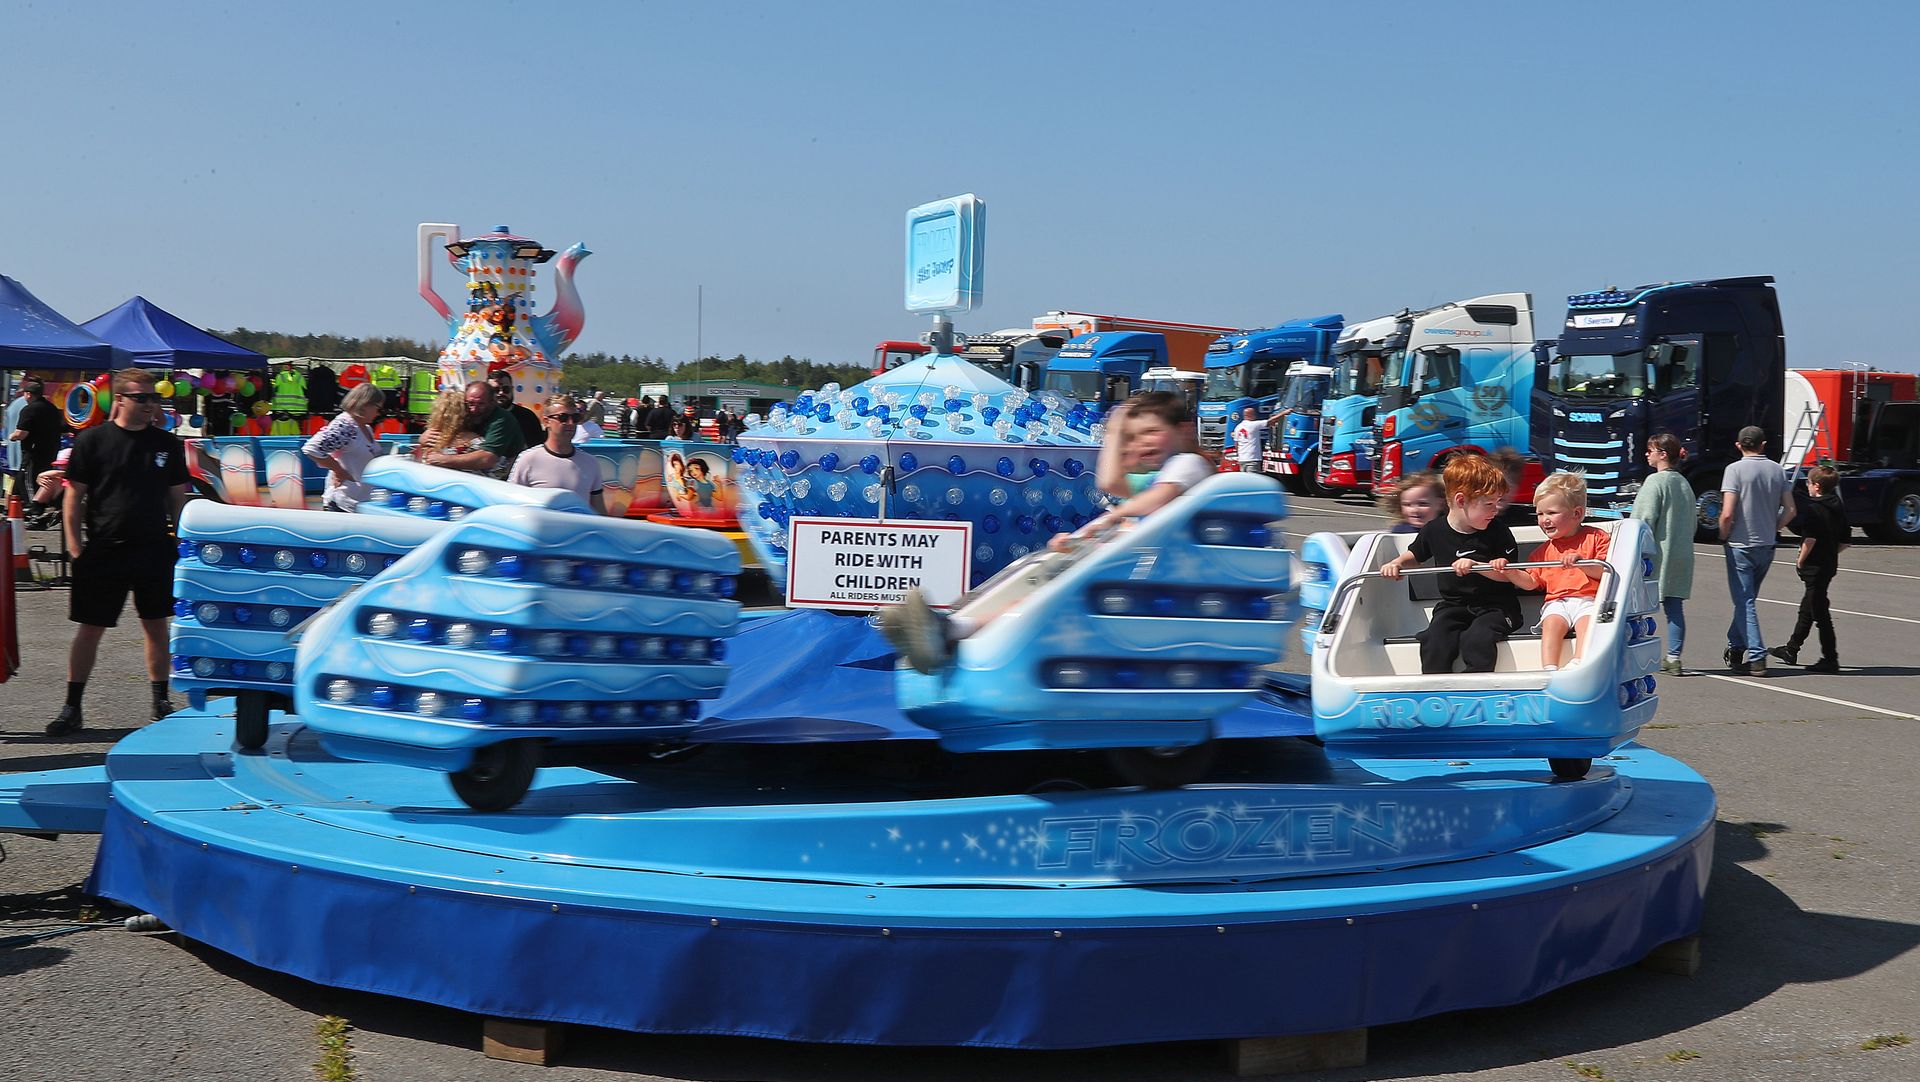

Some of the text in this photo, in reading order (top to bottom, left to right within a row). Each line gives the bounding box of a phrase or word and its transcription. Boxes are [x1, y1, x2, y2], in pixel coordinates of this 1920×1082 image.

[1569, 412, 1603, 423] SCANIA
[821, 531, 940, 547] PARENTS MAY
[835, 553, 923, 569] RIDE WITH
[835, 574, 921, 590] CHILDREN
[830, 591, 907, 602] ALL RIDERS MUST
[1358, 693, 1556, 729] FROZEN
[1036, 802, 1402, 869] FROZEN
